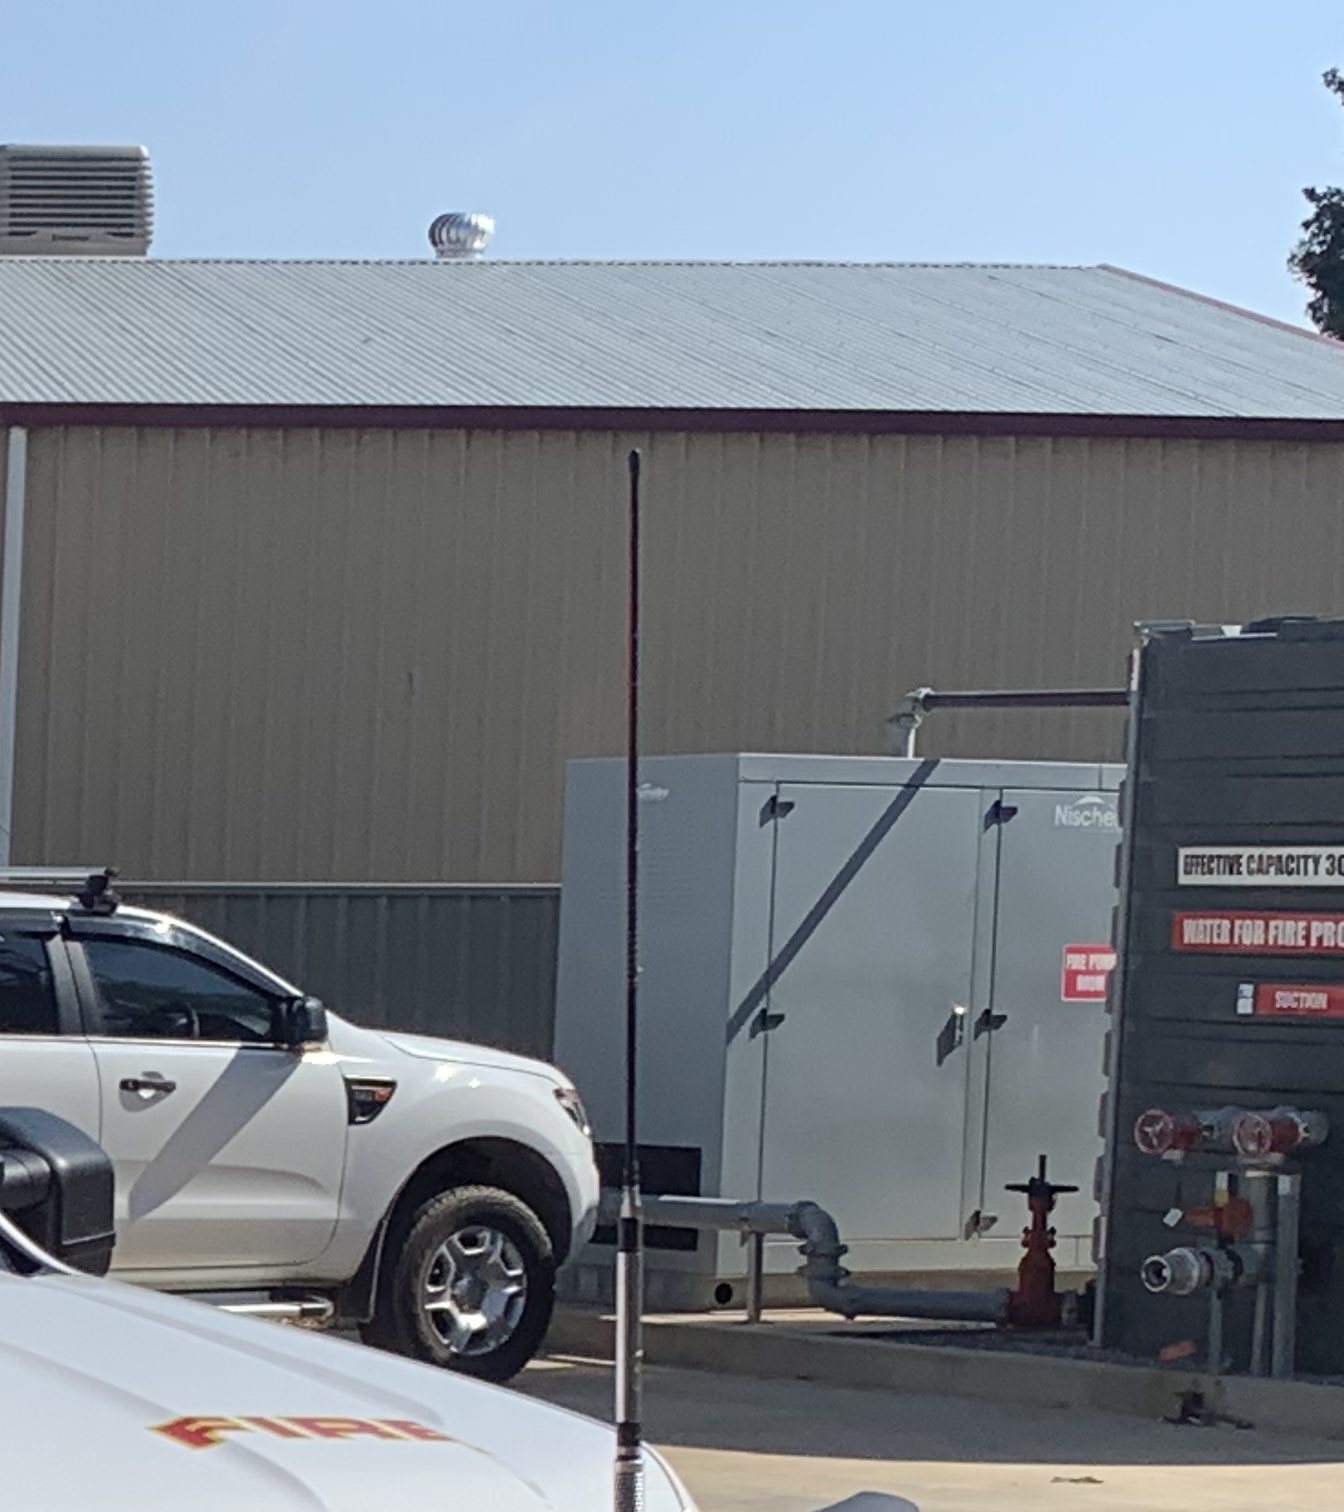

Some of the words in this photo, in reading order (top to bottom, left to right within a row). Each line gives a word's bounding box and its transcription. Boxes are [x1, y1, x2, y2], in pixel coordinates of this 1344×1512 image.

[1183, 854, 1242, 876] EFFECTIVE
[1247, 854, 1322, 877] CAPACITY
[1182, 918, 1230, 945] WATER
[1233, 918, 1265, 946] FOR
[1268, 919, 1308, 947] FIRE
[1275, 991, 1328, 1010] SUCTION
